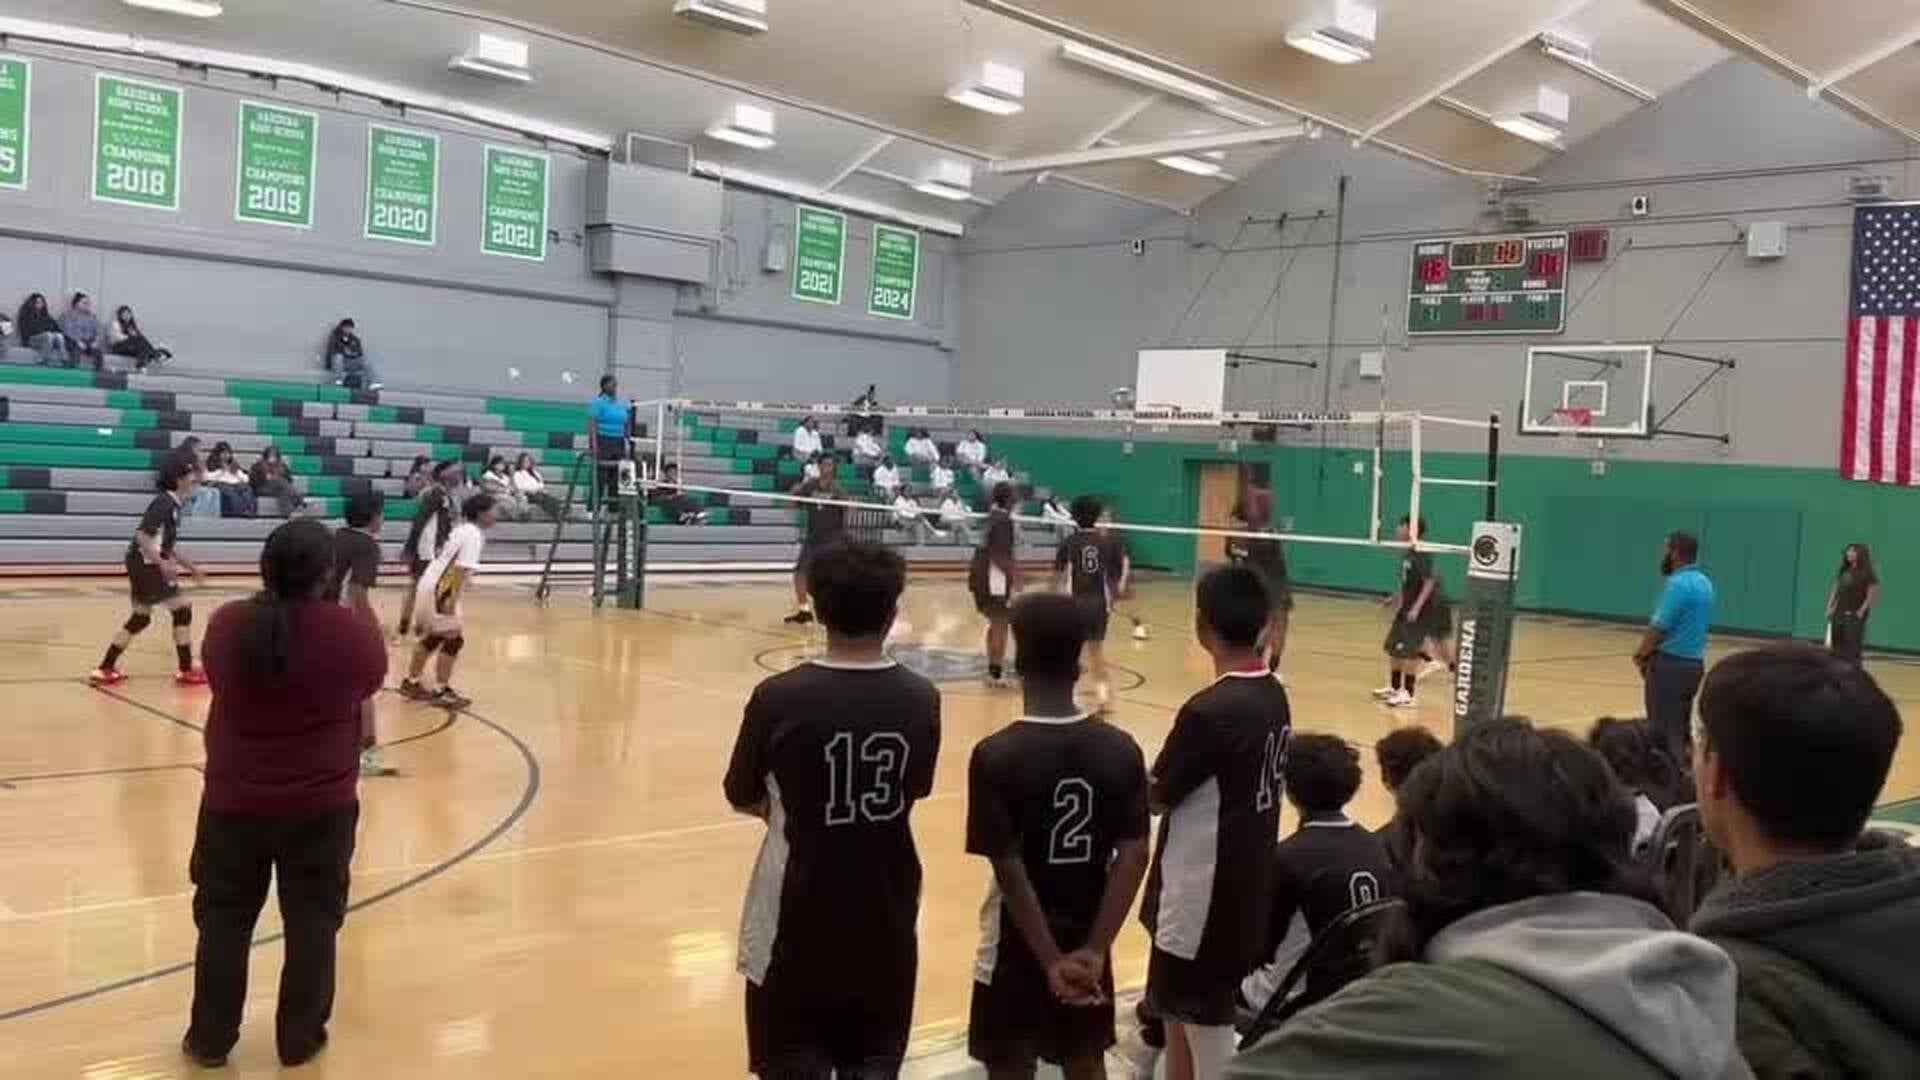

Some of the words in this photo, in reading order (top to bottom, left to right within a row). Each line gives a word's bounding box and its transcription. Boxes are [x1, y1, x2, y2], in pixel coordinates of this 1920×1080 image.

[107, 162, 166, 196] 2018
[248, 184, 301, 215] 2019
[373, 202, 428, 233] 2020
[491, 220, 536, 249] 2021
[800, 269, 834, 295] 2021
[873, 287, 909, 311] 2024
[1455, 619, 1477, 716] GARDENA
[825, 732, 910, 825] 13
[1048, 777, 1094, 864] 2
